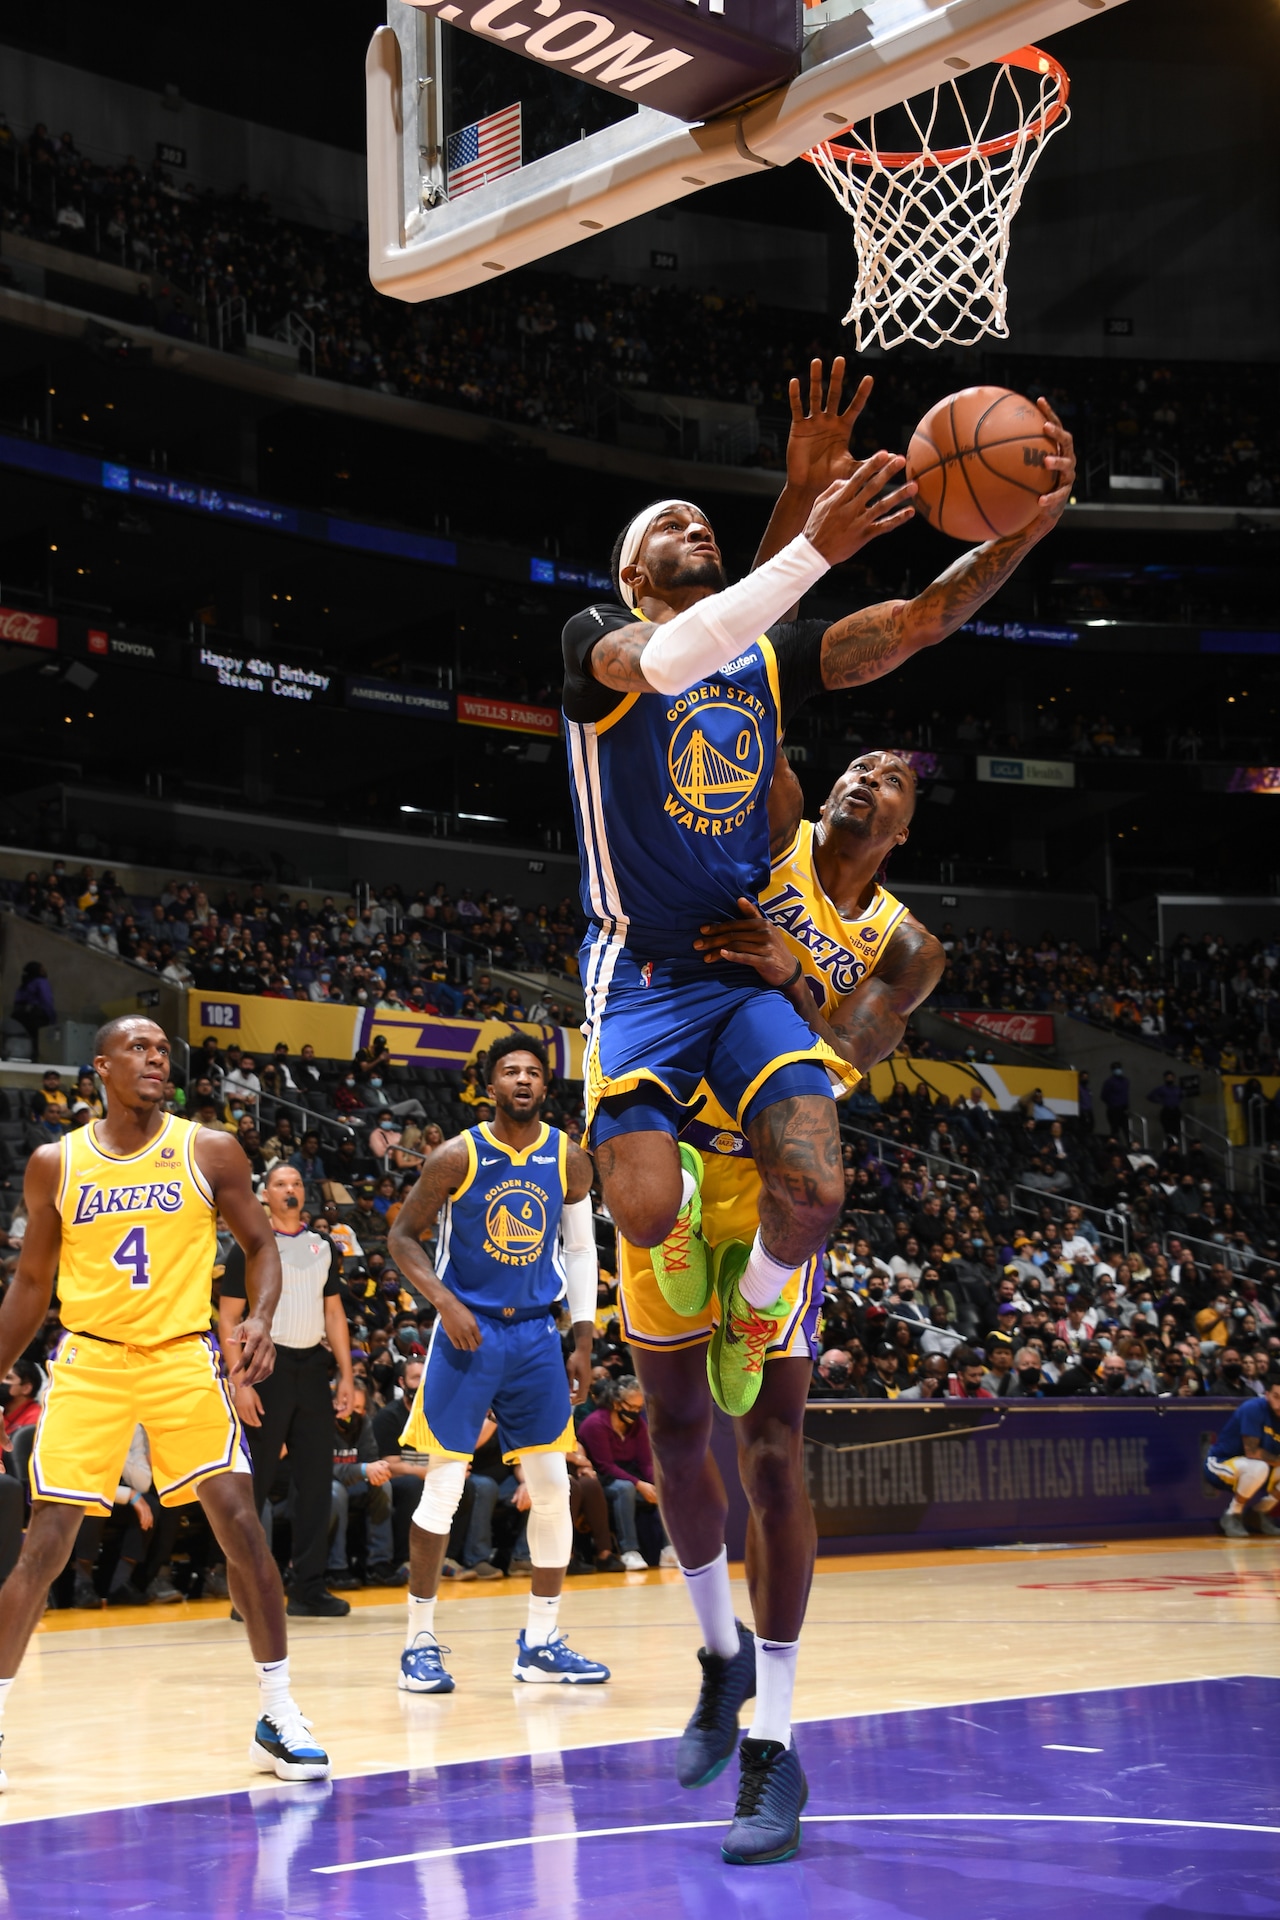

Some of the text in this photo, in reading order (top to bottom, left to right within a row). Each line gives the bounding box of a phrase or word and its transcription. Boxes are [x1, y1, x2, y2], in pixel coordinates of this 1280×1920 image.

[402, 0, 694, 92] .COM
[110, 639, 155, 658] TOYOTA
[200, 648, 330, 690] Happy 40th Birthday
[719, 654, 758, 675] akuten
[218, 667, 264, 692] Steven
[352, 687, 450, 710] AMERICAN EXPRESS
[667, 685, 766, 721] GOLDEN STATE
[463, 702, 553, 727] WELLS FARGO
[735, 729, 751, 760] 0
[993, 763, 1064, 781] UCLA Health
[207, 1004, 234, 1026] 102
[155, 1160, 181, 1170] bibigo
[484, 1179, 549, 1202] GOLDEN STATE
[72, 1182, 183, 1225] LAKERS
[521, 1200, 533, 1220] 6
[112, 1226, 150, 1287] 4
[822, 1440, 928, 1507] OFFICIAL
[931, 1439, 982, 1503] NBA
[987, 1438, 1085, 1500] FANTASY
[1091, 1437, 1150, 1496] GAME
